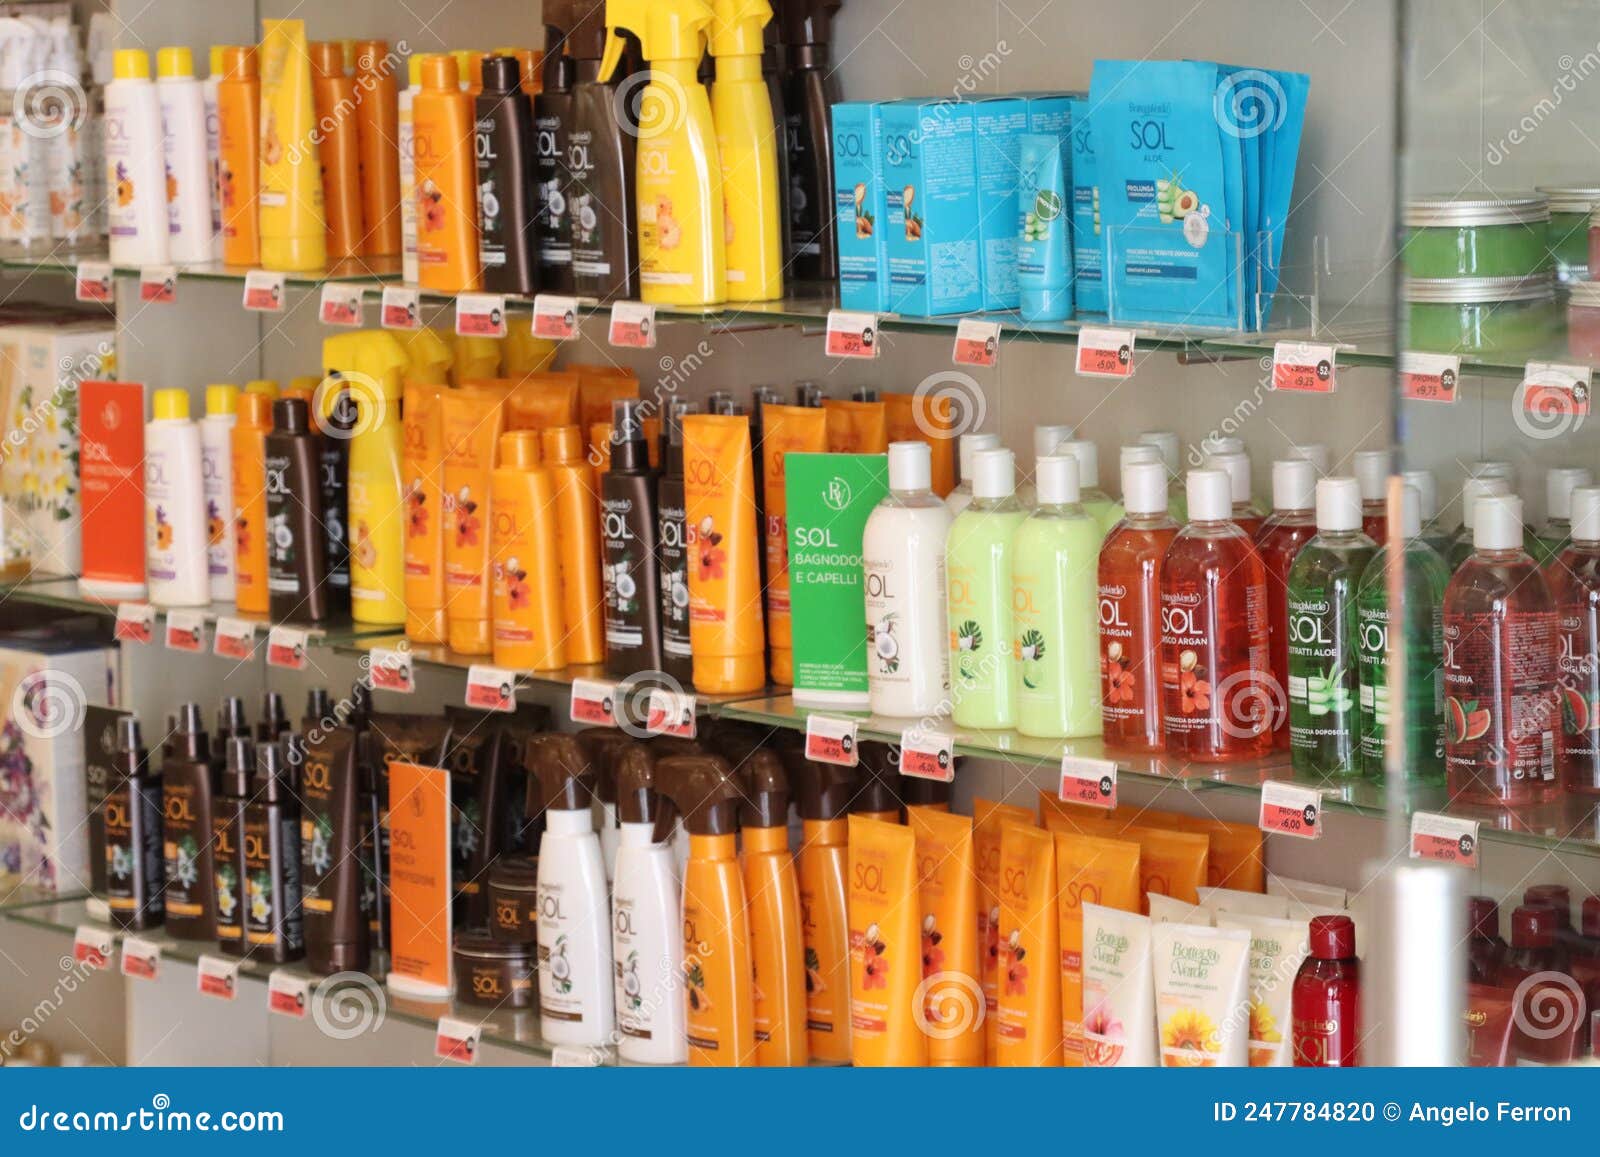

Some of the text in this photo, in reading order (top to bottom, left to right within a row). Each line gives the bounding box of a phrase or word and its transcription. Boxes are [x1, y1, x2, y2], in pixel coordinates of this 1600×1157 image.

[476, 133, 497, 158] OL
[1131, 121, 1175, 151] SOL
[268, 470, 291, 494] OL
[795, 527, 839, 548] SOL
[796, 572, 858, 585] E CAPELLI
[1162, 607, 1203, 635] SOL
[1290, 616, 1332, 644] SOL
[1106, 629, 1132, 637] ARGAN
[1178, 637, 1208, 646] ARGAN
[1314, 648, 1337, 658] ALOE
[303, 761, 333, 791] SOL
[1278, 806, 1302, 818] PROMO
[854, 863, 888, 895] SOL
[496, 907, 522, 925] SOL
[1095, 927, 1129, 953] Bottega
[1250, 937, 1282, 957] ottega
[1172, 940, 1220, 967] Bottega
[1170, 958, 1209, 981] Verde
[473, 976, 504, 994] SOL
